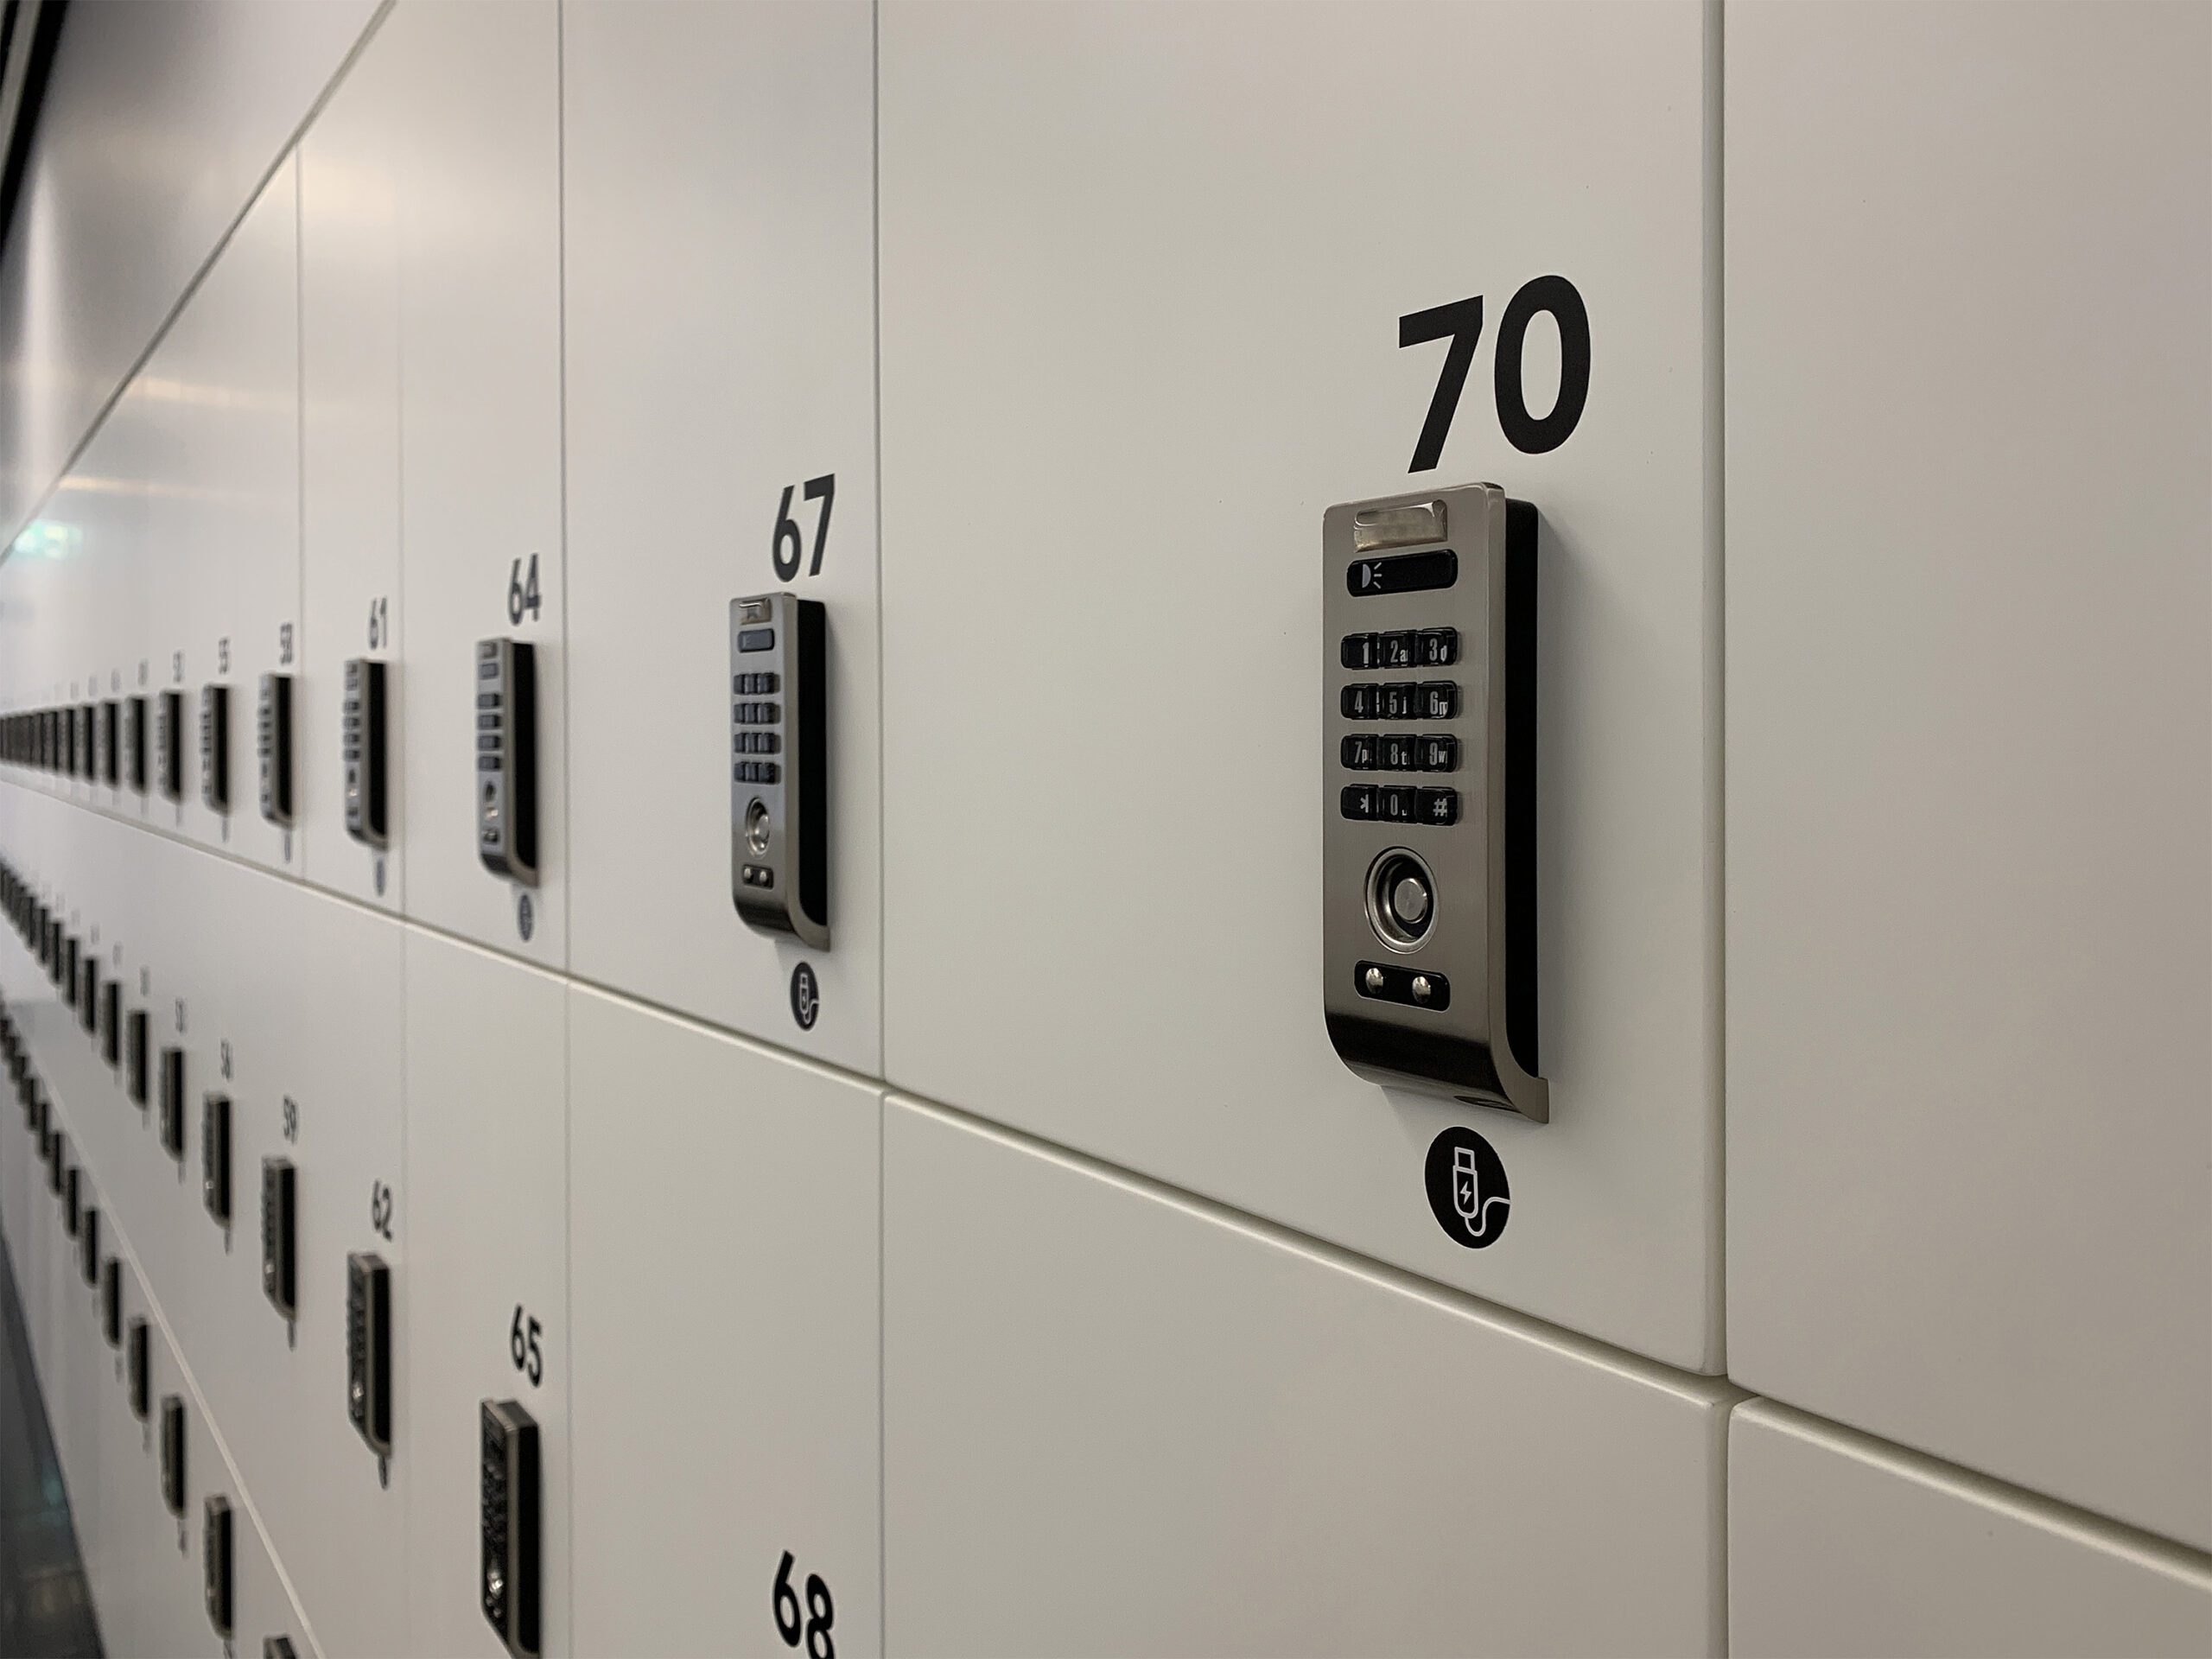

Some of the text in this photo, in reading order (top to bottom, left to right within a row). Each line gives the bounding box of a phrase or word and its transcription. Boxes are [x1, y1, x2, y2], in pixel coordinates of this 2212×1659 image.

[1398, 274, 1592, 474] 70
[772, 474, 835, 582] 67
[367, 596, 388, 650] 61
[507, 552, 541, 626] 64
[372, 1179, 392, 1242] 62
[511, 1302, 543, 1388] 65
[772, 1548, 836, 1659] 68
